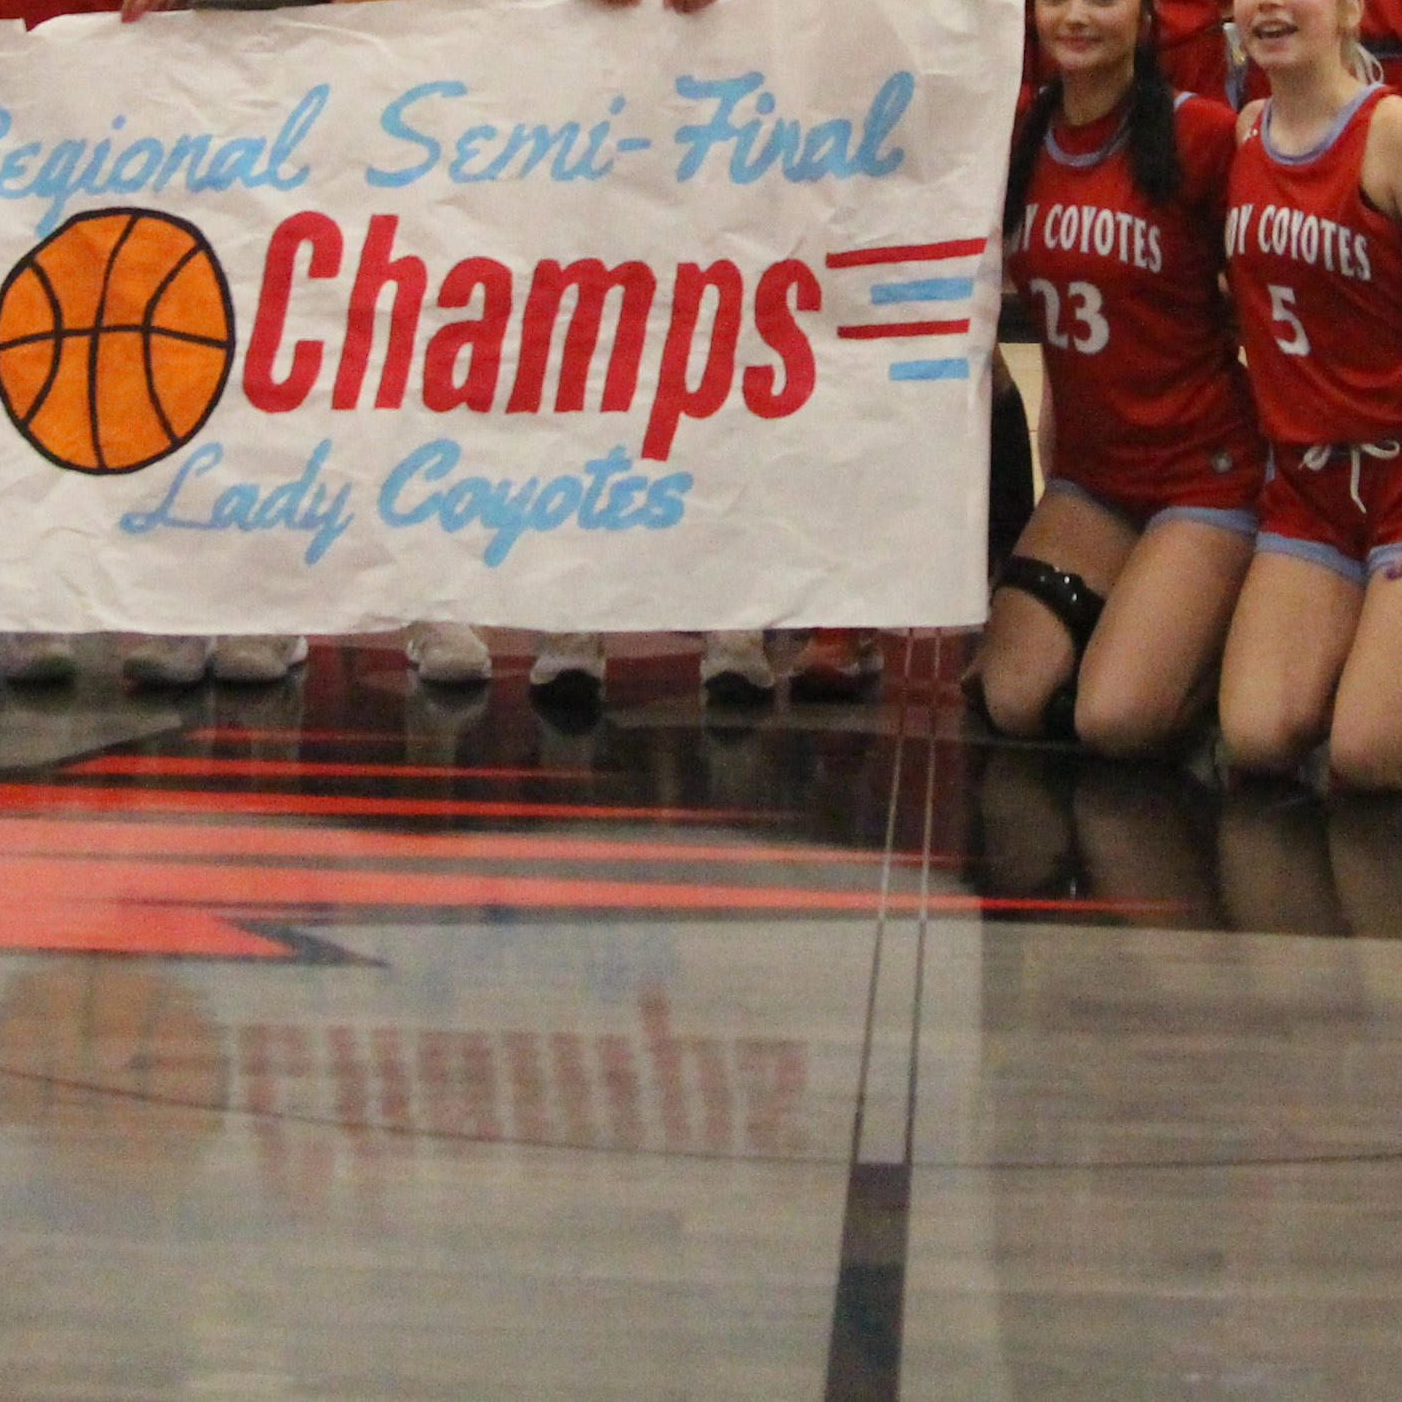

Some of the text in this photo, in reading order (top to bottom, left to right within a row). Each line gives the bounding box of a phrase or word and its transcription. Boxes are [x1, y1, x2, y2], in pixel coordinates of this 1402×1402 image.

[365, 70, 915, 190] Semi-Final
[1043, 203, 1163, 274] COYOTES
[1257, 203, 1371, 282] COYOTES
[242, 212, 822, 461] Champs
[1028, 278, 1110, 355] 23
[1267, 284, 1311, 356] 5
[120, 440, 694, 568] Lady Coyotes
